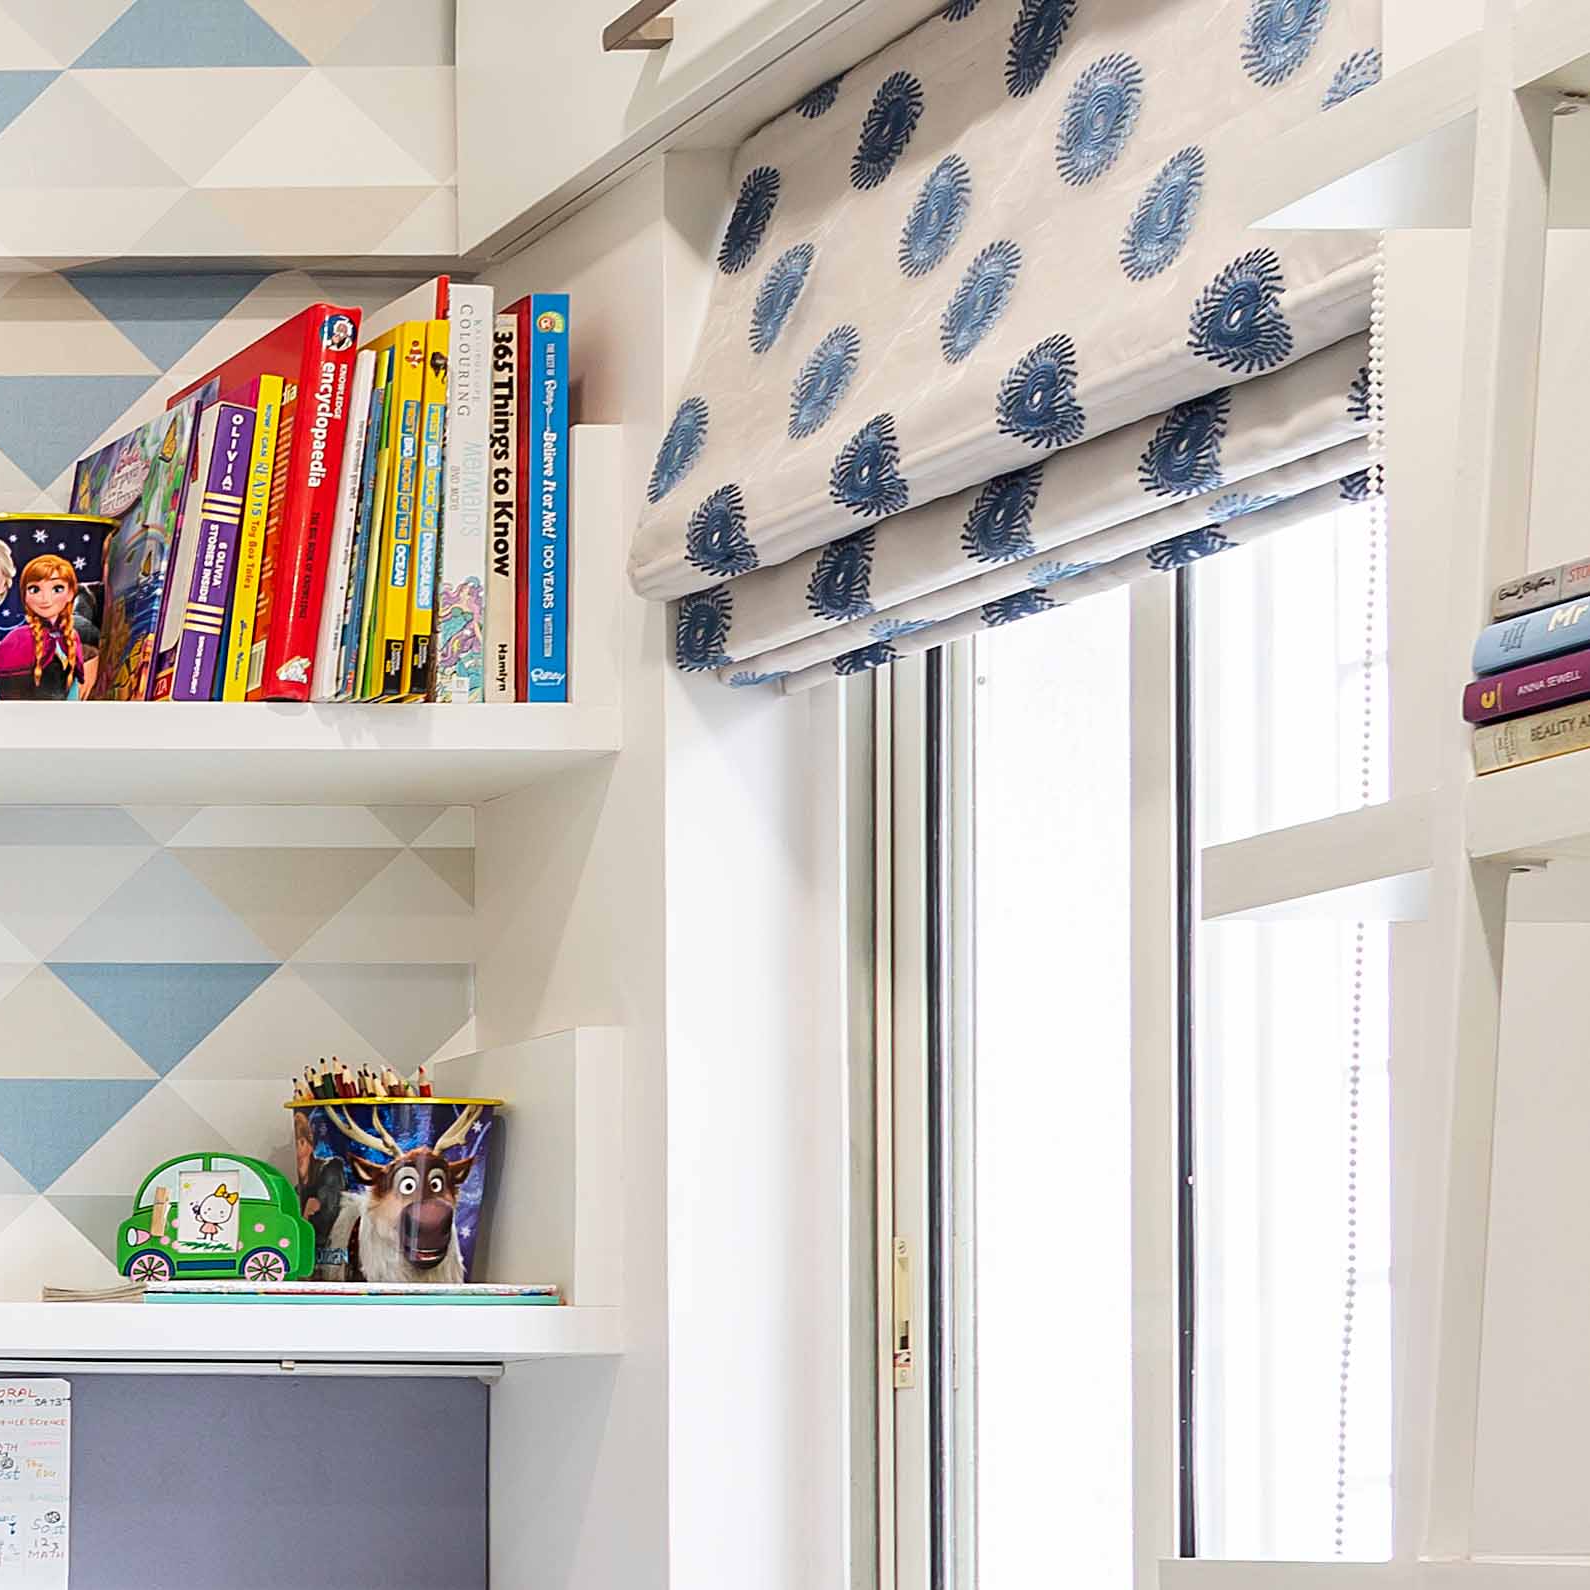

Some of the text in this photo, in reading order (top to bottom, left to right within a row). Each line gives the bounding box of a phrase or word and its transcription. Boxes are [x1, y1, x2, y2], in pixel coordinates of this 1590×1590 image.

[457, 304, 473, 417] COLOURING
[333, 363, 348, 420] KNOWLEDGE
[307, 361, 335, 488] encyclopaedia
[221, 414, 244, 491] OLIVIA
[402, 436, 415, 457] BIG
[425, 445, 438, 466] BIG
[489, 331, 513, 576] 365 Things to Know
[542, 431, 556, 476] Believe
[251, 460, 270, 499] READ
[398, 458, 414, 492] BOOK
[543, 480, 555, 493] It
[251, 501, 263, 516] 15
[398, 495, 412, 512] OF
[542, 494, 554, 508] or
[248, 521, 260, 538] Toy
[395, 513, 410, 540] THE
[541, 511, 556, 540] Not!
[197, 523, 219, 603] STORIES INSIDE
[246, 541, 258, 560] Box
[542, 545, 554, 569] 100
[212, 542, 228, 588] 6 OLIVIA
[243, 562, 256, 589] Tales
[392, 544, 409, 587] OCEAN
[417, 531, 435, 609] DINOSAURS
[542, 571, 554, 608] YEARS
[1547, 604, 1589, 632] Mr
[496, 643, 508, 692] Hamlyn
[1517, 680, 1545, 696] ANNA
[1531, 717, 1576, 742] BEAUTY
[28, 1418, 67, 1426] SCIENCE
